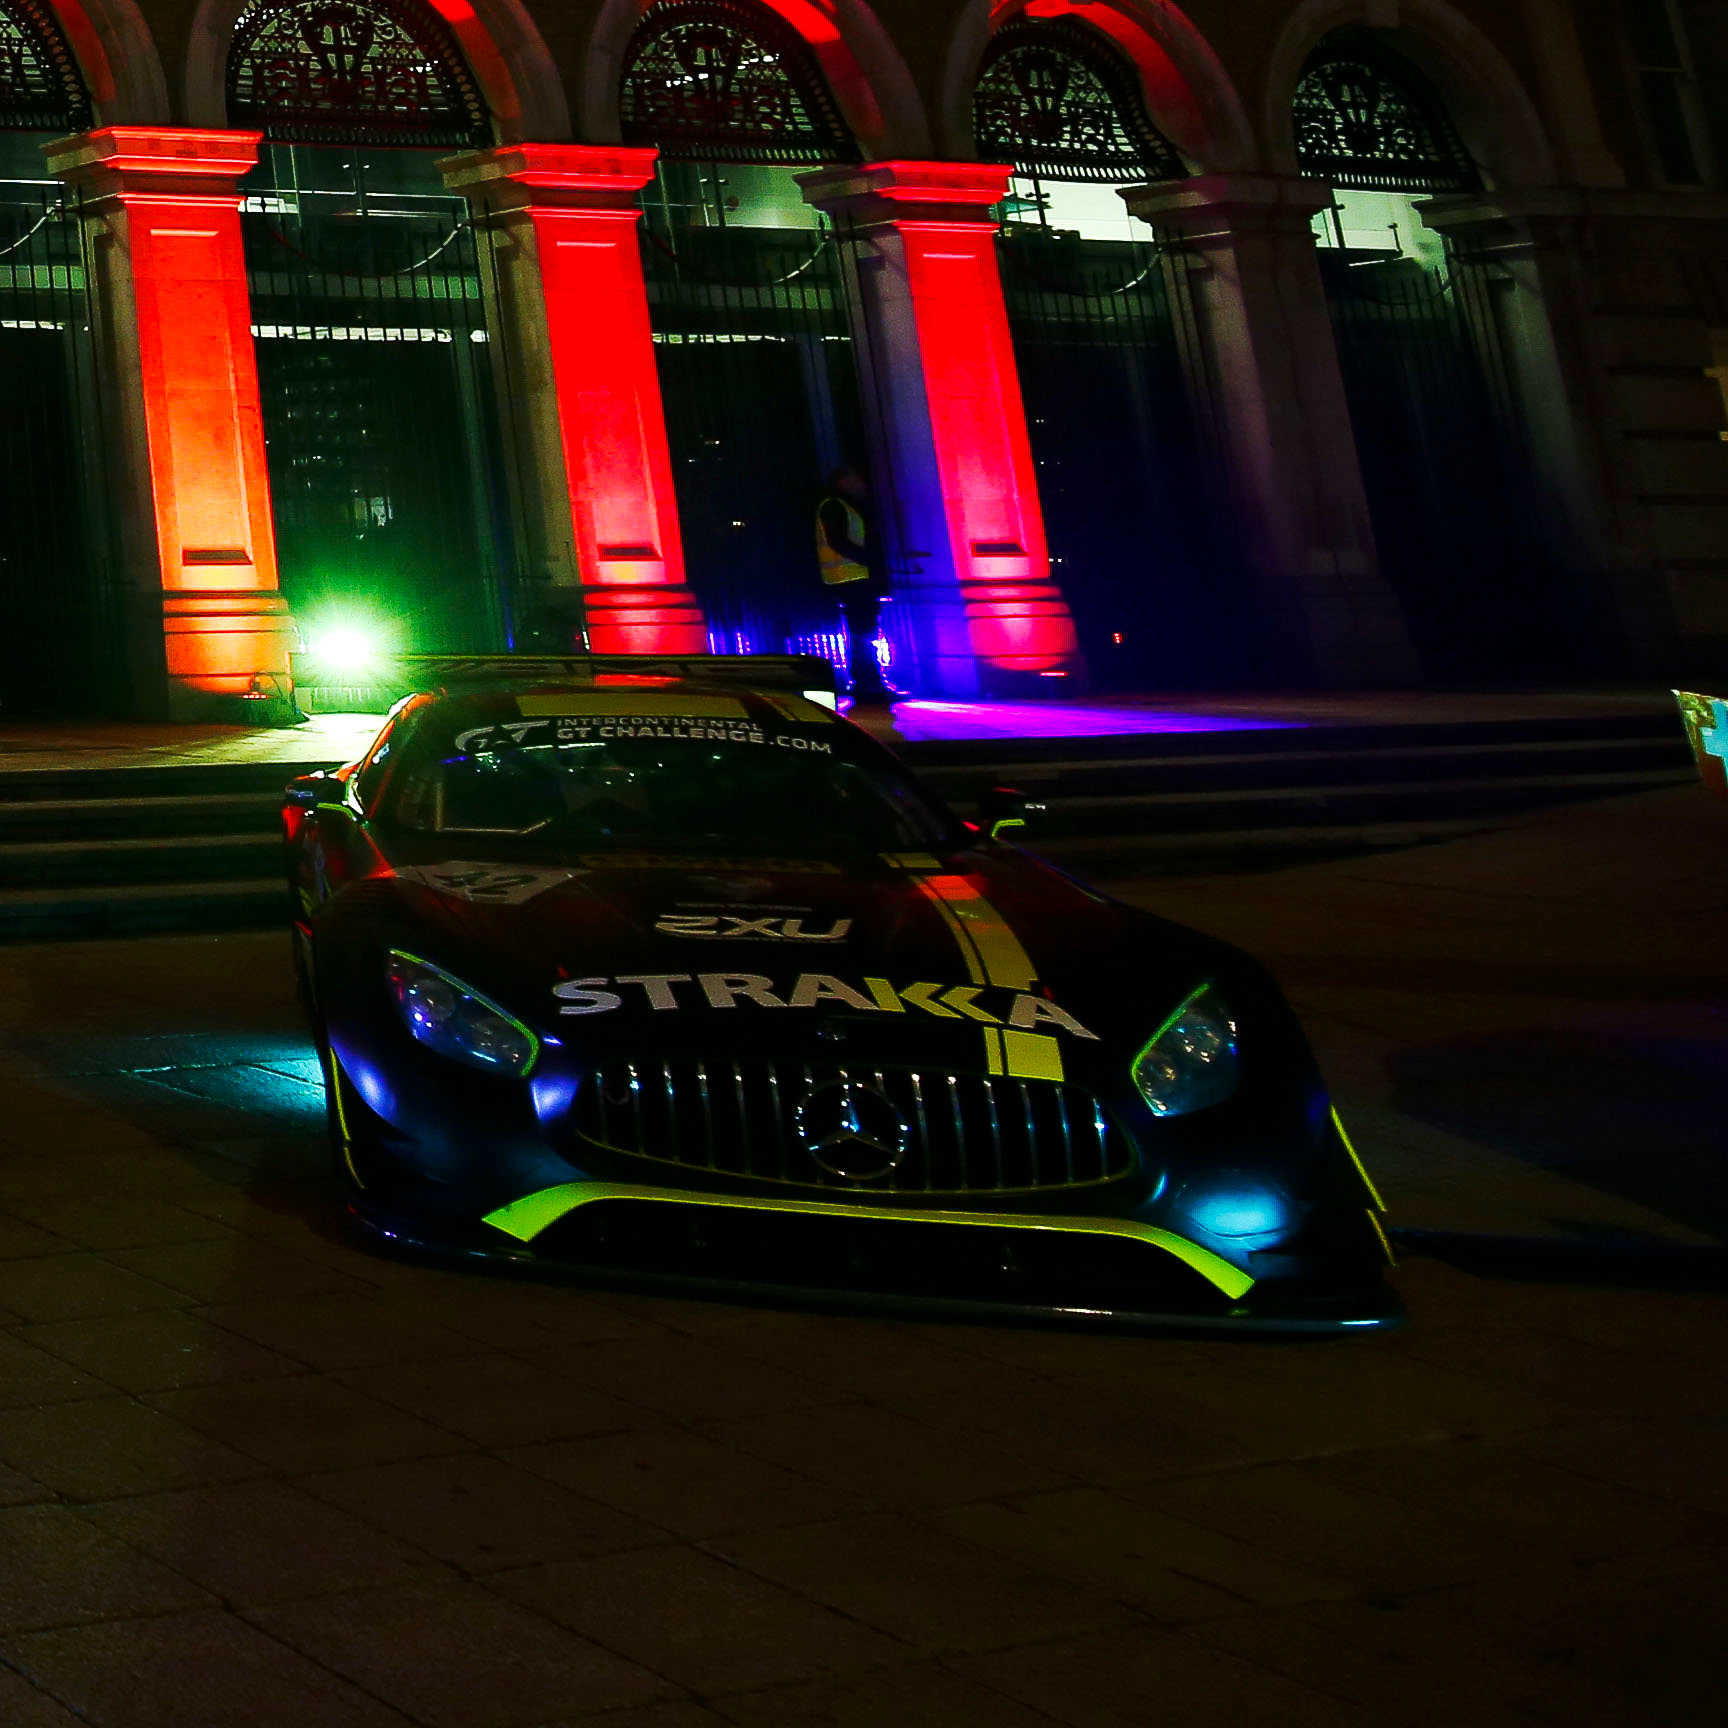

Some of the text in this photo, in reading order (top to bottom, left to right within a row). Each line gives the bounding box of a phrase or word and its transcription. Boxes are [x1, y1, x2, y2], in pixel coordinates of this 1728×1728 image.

[556, 717, 764, 733] INTERCONTINENTAL
[557, 727, 833, 754] GT CHALLENGE.COM
[655, 913, 855, 940] 2XU
[552, 972, 1102, 1041] STRAKKA
